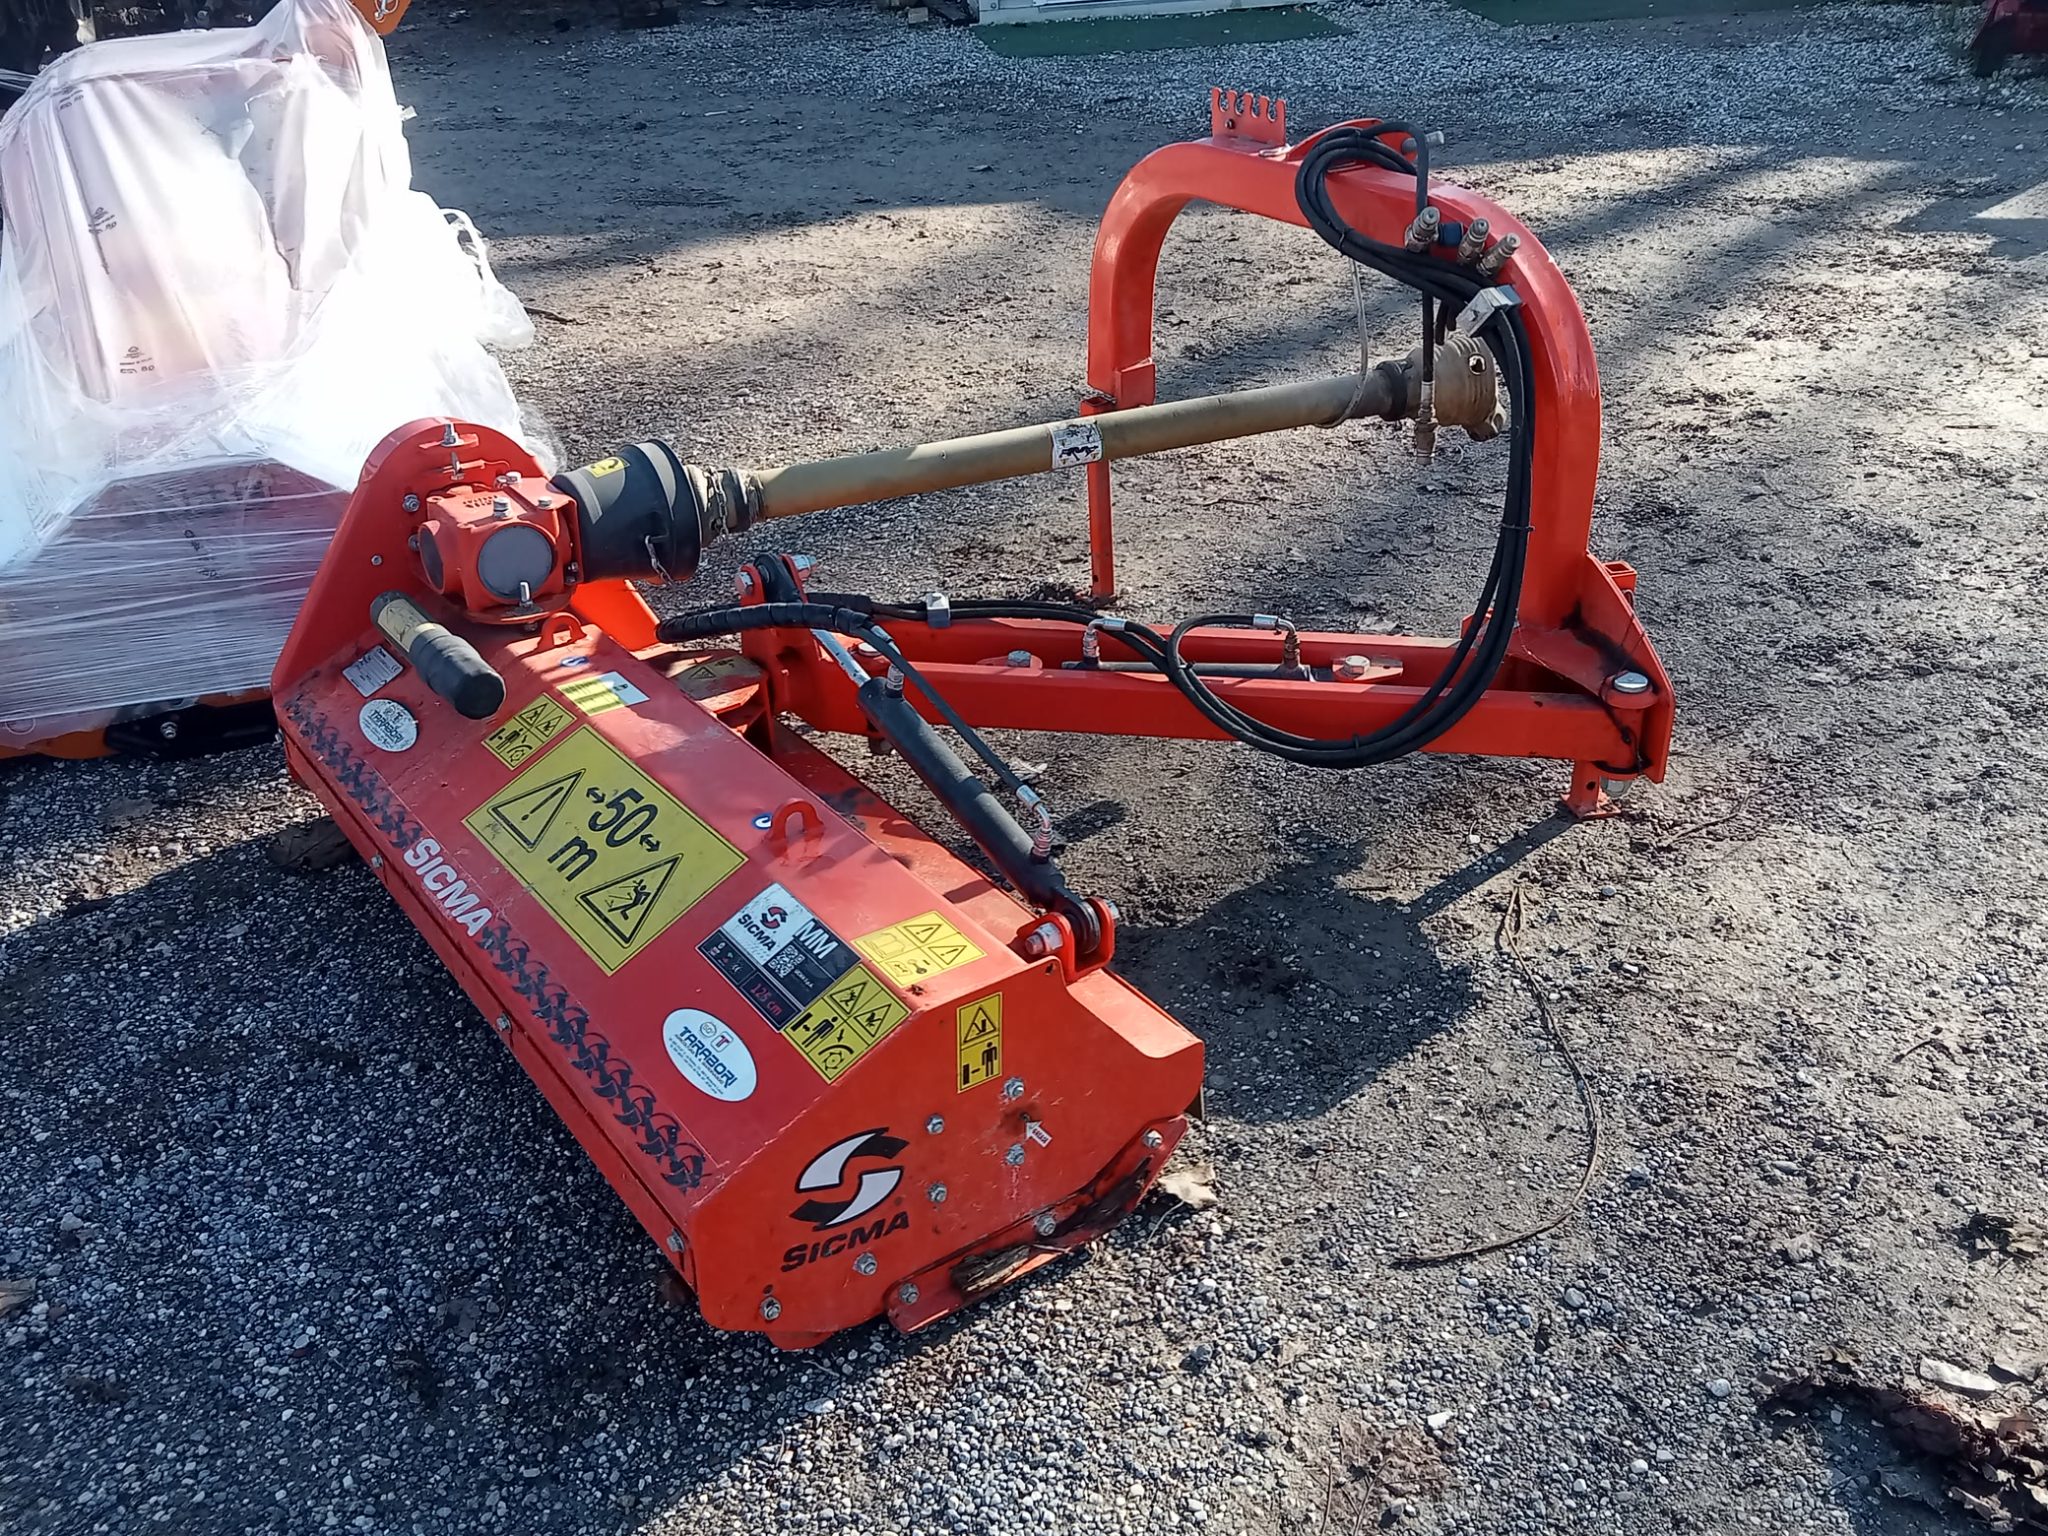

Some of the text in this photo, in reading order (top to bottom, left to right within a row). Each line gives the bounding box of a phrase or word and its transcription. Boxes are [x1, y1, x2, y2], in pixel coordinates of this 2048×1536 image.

[588, 787, 658, 848] 50
[547, 836, 598, 882] m
[403, 837, 494, 937] SICMA
[737, 913, 777, 952] SICMA
[794, 919, 839, 960] MM
[750, 983, 783, 1017] 125 cm
[679, 1026, 739, 1089] TARABORI
[780, 1210, 910, 1273] SICMA
